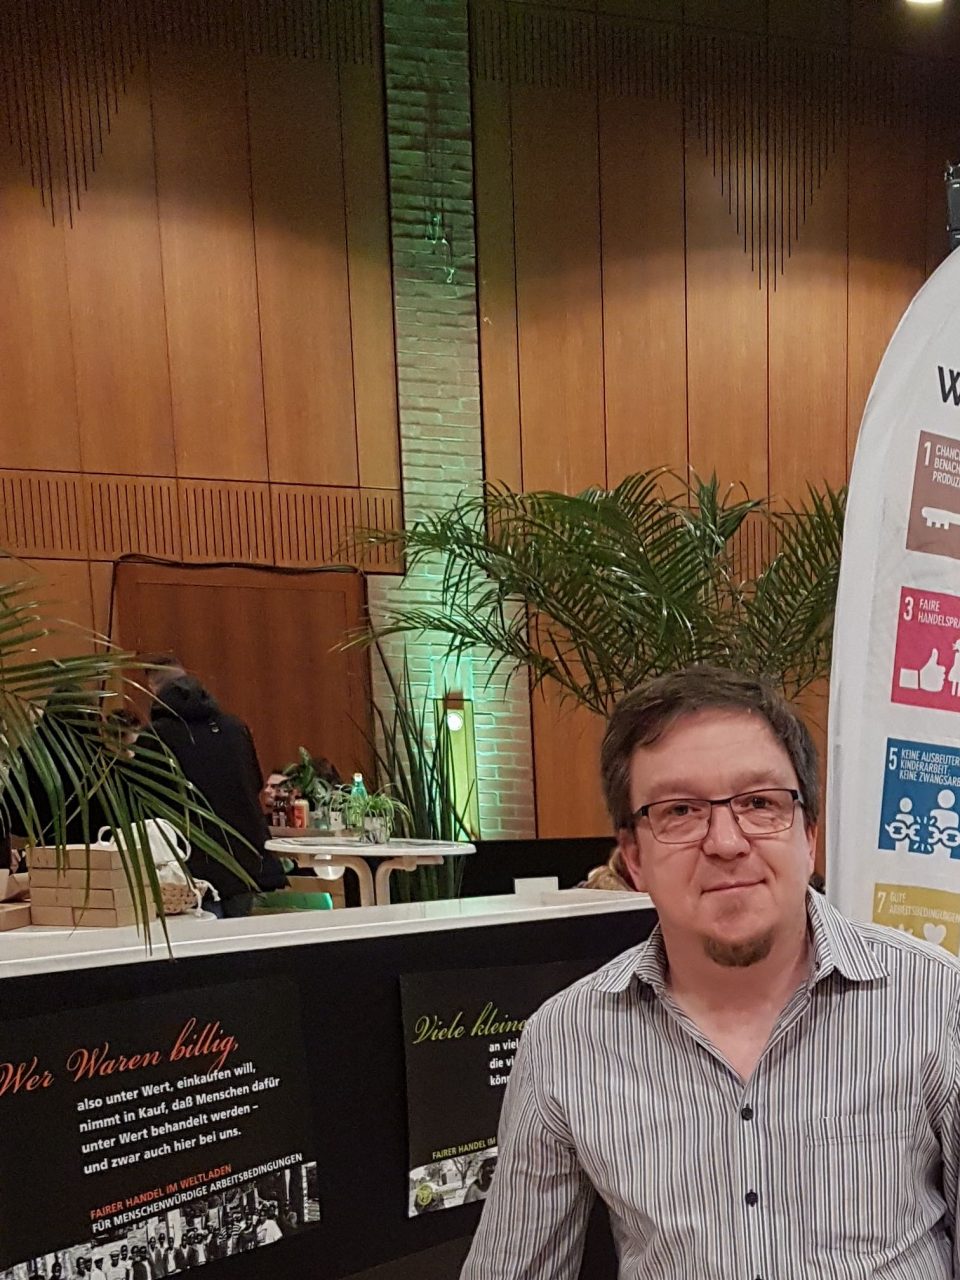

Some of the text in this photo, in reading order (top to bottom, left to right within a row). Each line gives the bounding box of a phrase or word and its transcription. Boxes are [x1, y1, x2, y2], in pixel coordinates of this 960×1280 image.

[924, 441, 932, 466] 1
[903, 596, 914, 621] 3
[919, 598, 940, 612] FAIRE
[888, 747, 898, 770] 5
[901, 748, 920, 761] KEINE
[899, 770, 919, 781] KEINE
[878, 891, 887, 913] 7
[890, 891, 906, 903] GUTE
[412, 1011, 465, 1044] Viele
[0, 1017, 240, 1097] Wer Waren billig,
[489, 1042, 500, 1052] an
[489, 1058, 504, 1069] die
[76, 1062, 256, 1112] also unter Wert, einkaufen will,
[79, 1076, 281, 1133] nimmt in Kauf, daß Menschen dafür
[81, 1106, 251, 1154] unter Wert behandelt werden
[83, 1126, 242, 1175] und zwar auch hier bei uns.
[432, 1136, 496, 1160] FAIRER HANDEL IM
[90, 1164, 232, 1220] FAIRER HANDEL IM WELTLADEN
[92, 1152, 303, 1234] FÜR MENSCHENWÜRDIGE ARBEITSBEDINGUNGEN
